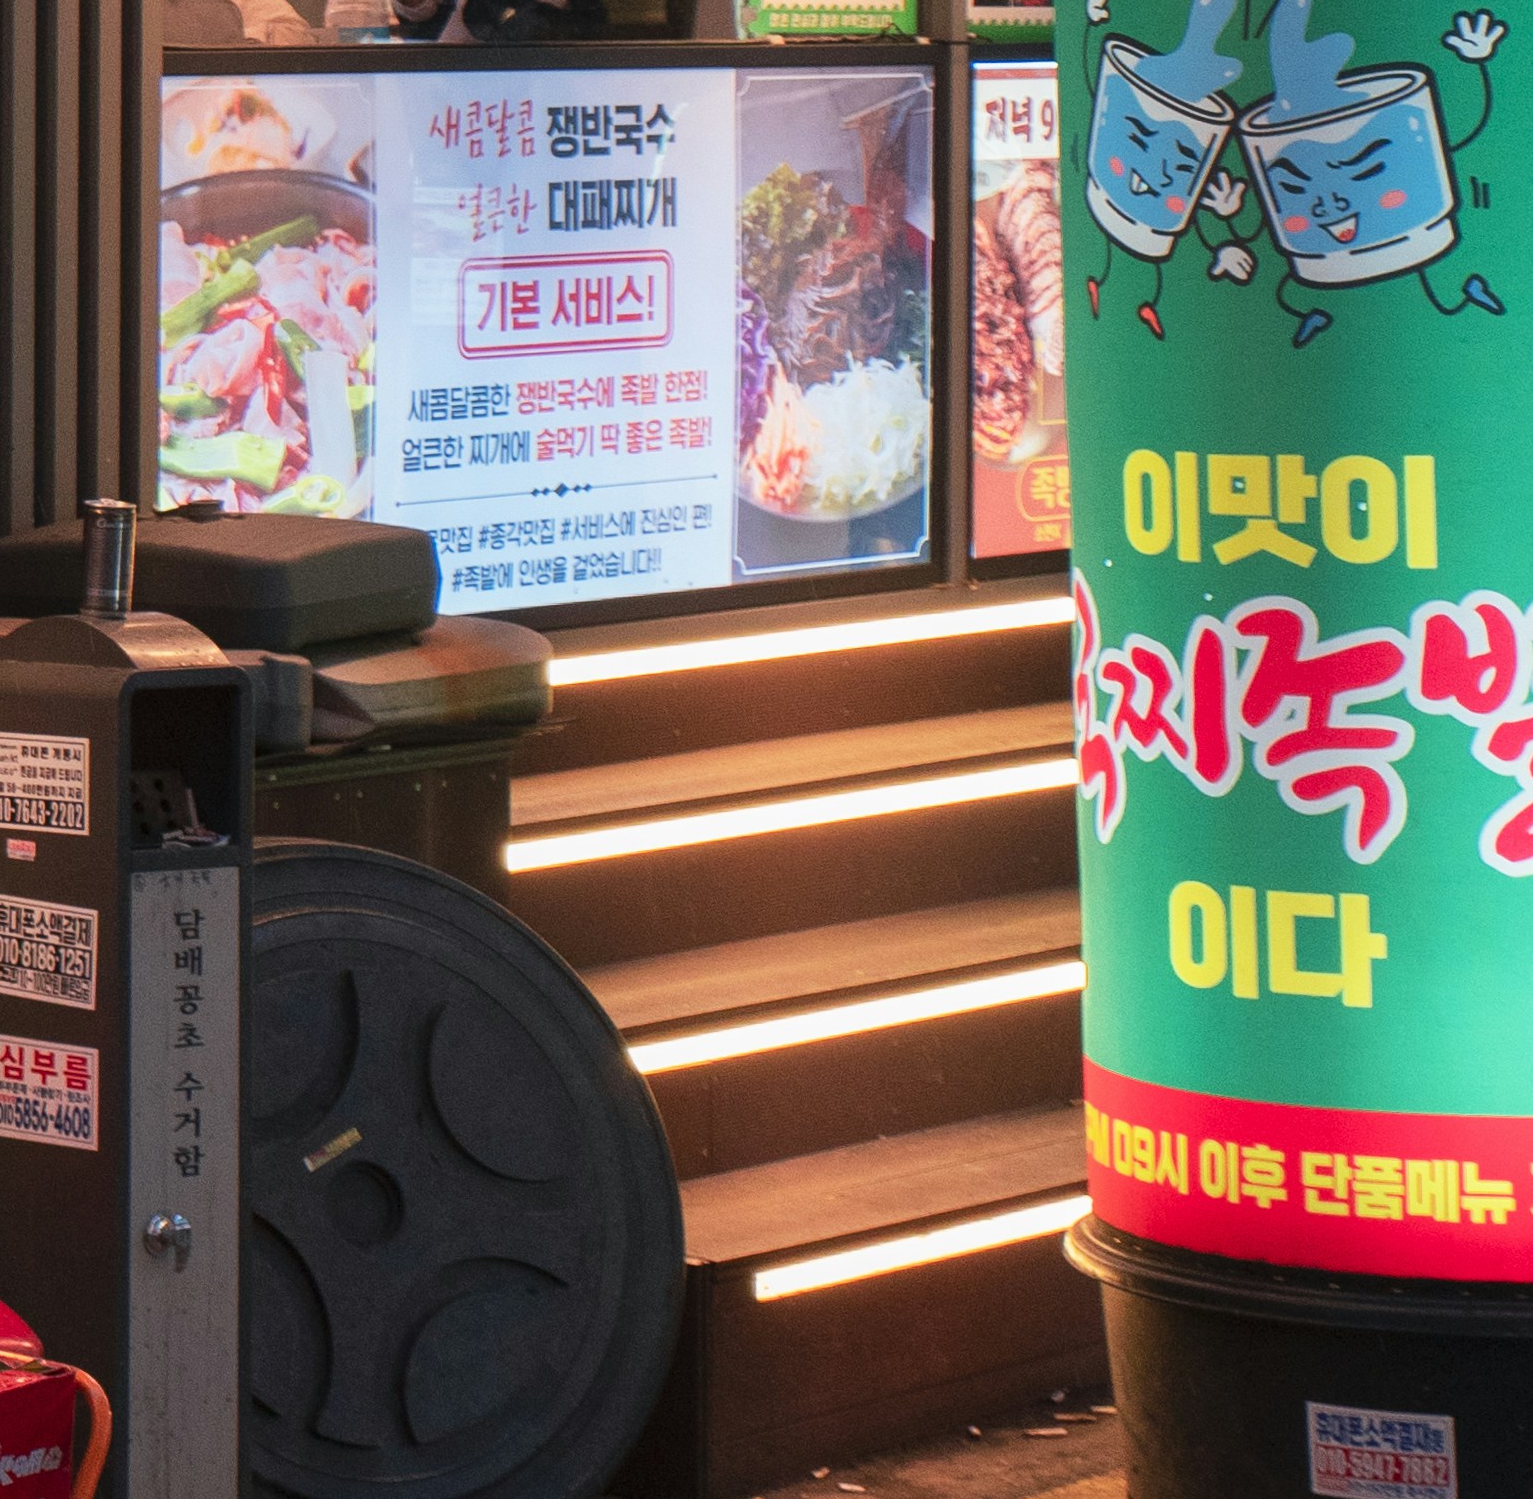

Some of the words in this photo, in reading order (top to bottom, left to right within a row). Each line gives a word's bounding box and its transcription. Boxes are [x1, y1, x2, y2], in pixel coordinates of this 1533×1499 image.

[429, 98, 536, 160] 새콤달콤
[546, 103, 676, 160] 쟁반국수
[456, 182, 537, 243] 얼큰한
[548, 176, 678, 232] 대패찌개
[477, 279, 541, 332] 기본
[551, 274, 655, 328] 서비스!
[407, 383, 511, 423] 새콤달콤한
[516, 376, 615, 417] 쟁반국수에
[621, 372, 659, 406] 족발
[664, 369, 709, 404] 한점!
[401, 434, 465, 473] 얼큰한
[468, 429, 530, 466] 찌개에
[536, 424, 595, 461] 술먹기
[601, 422, 621, 455] 딱
[669, 416, 713, 449] 족발!
[478, 518, 556, 552] #종각맛집
[560, 510, 636, 544] #서비스에
[640, 504, 688, 536] 진심인
[1123, 448, 1439, 570] 이맛이
[452, 561, 514, 594] #족발에
[519, 554, 568, 588] 인생을
[573, 547, 663, 583] 걸었습니다!!
[1168, 879, 1389, 1009] 이다
[172, 907, 205, 1051] 담배꽁초
[172, 1070, 205, 1178] 수거함
[1112, 1118, 1190, 1196] 09시
[1199, 1139, 1288, 1209] 이후
[1300, 1150, 1517, 1227] 단품메뉴
